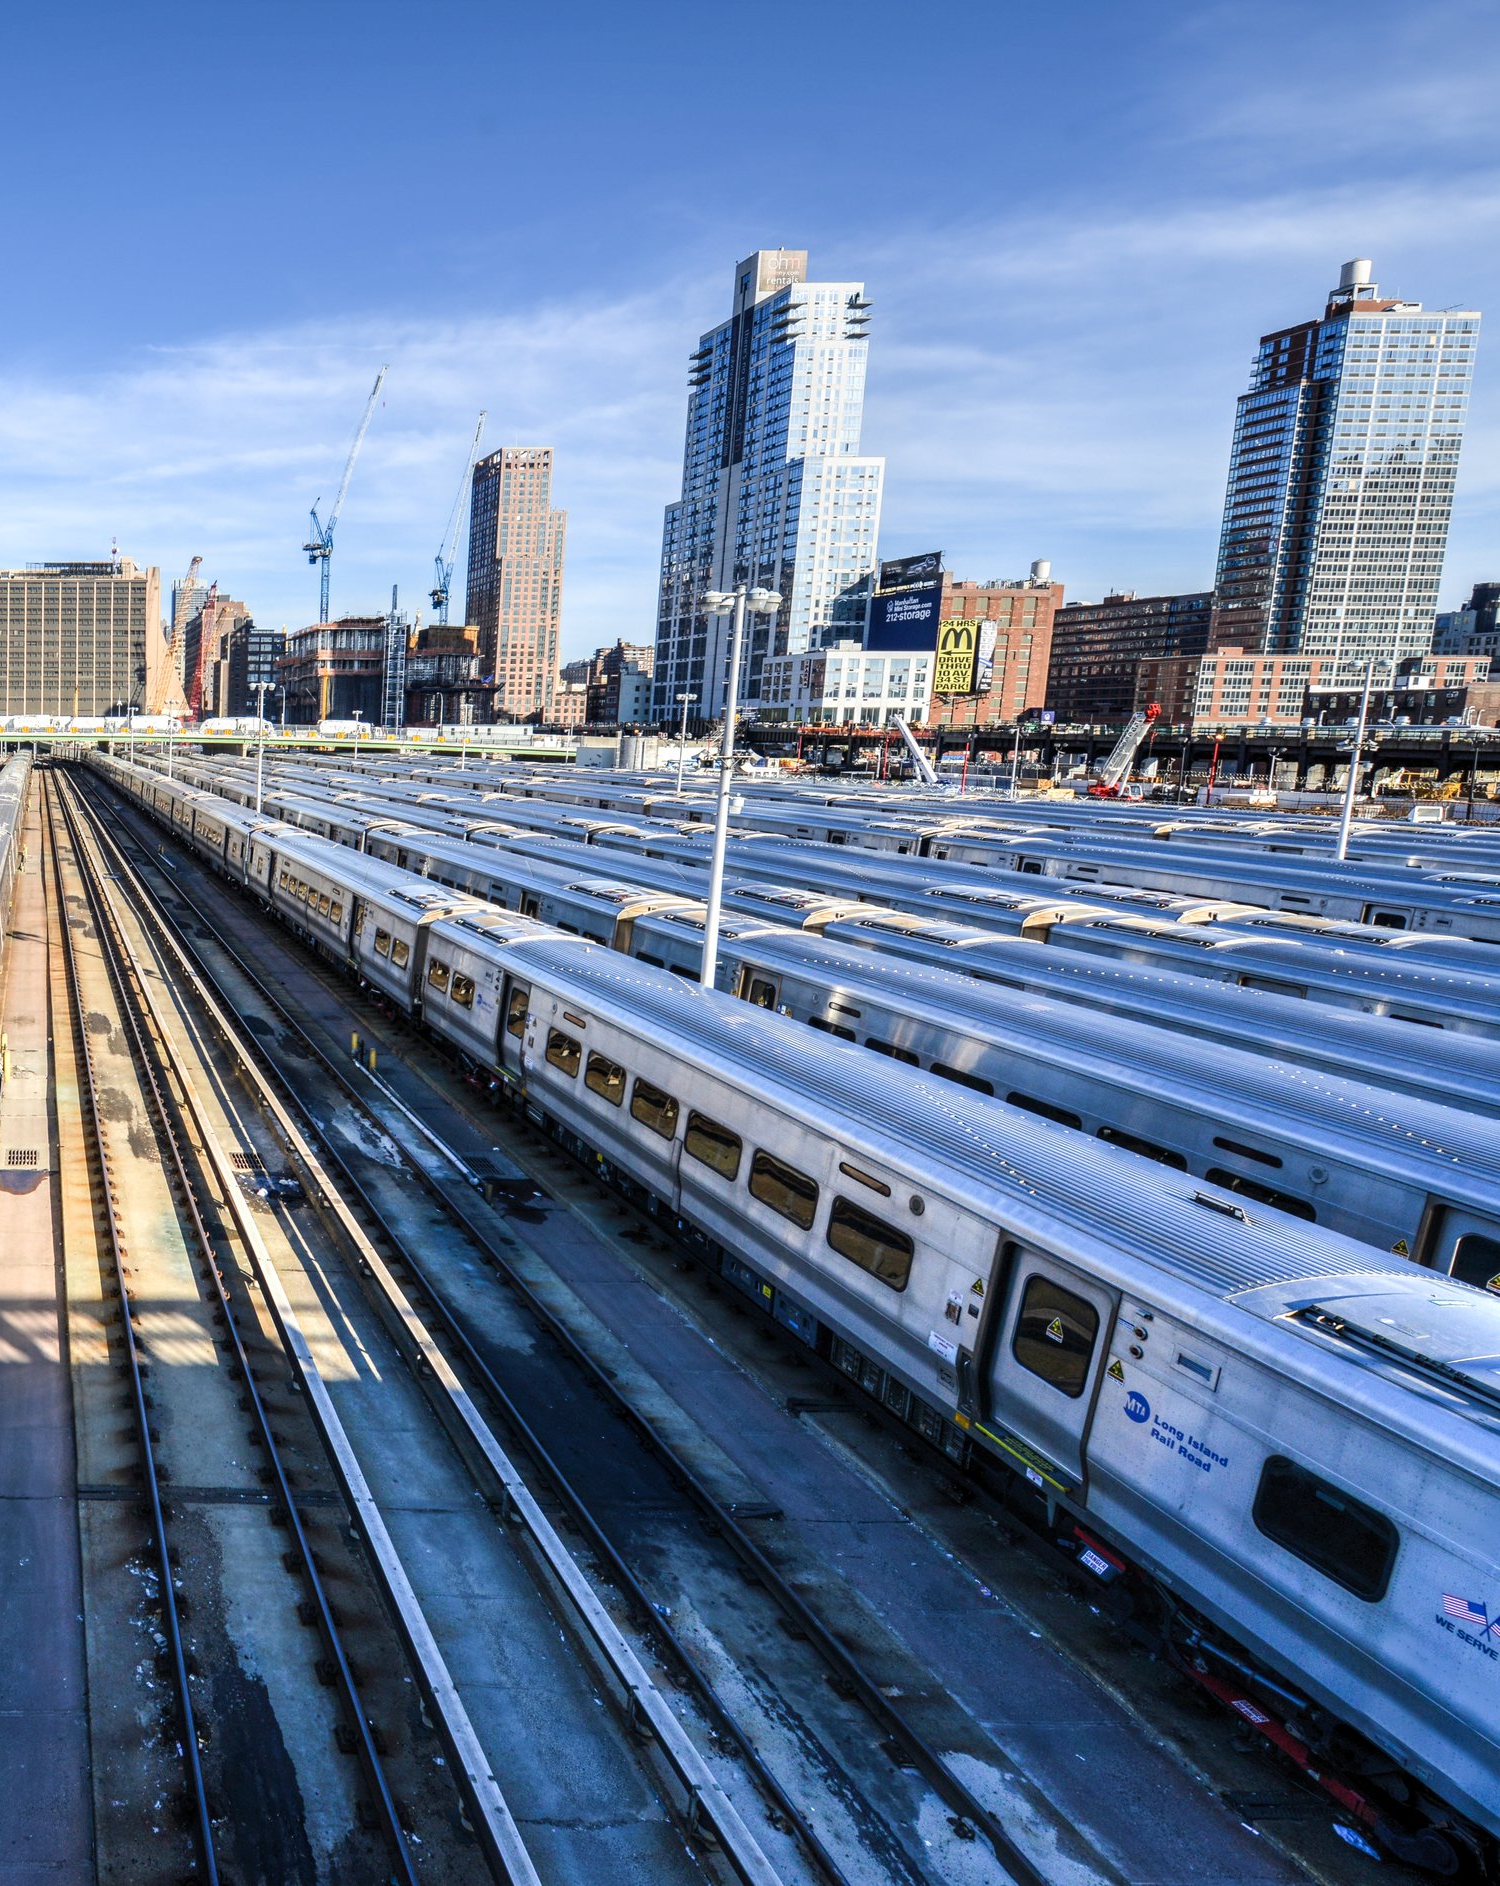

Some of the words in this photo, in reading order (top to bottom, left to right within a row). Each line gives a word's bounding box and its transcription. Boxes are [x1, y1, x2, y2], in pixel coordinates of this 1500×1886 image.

[766, 276, 799, 285] rentals
[894, 596, 919, 606] Manhattan
[885, 609, 931, 622] 212-storage
[1124, 1395, 1148, 1419] MTA
[1151, 1428, 1175, 1449] Rail
[1178, 1445, 1211, 1472] Road
[1154, 1414, 1184, 1441] Long
[1188, 1436, 1228, 1467] Island
[1086, 1550, 1108, 1569] DANGER
[1436, 1614, 1456, 1634] WE
[1457, 1629, 1499, 1662] SERVE
